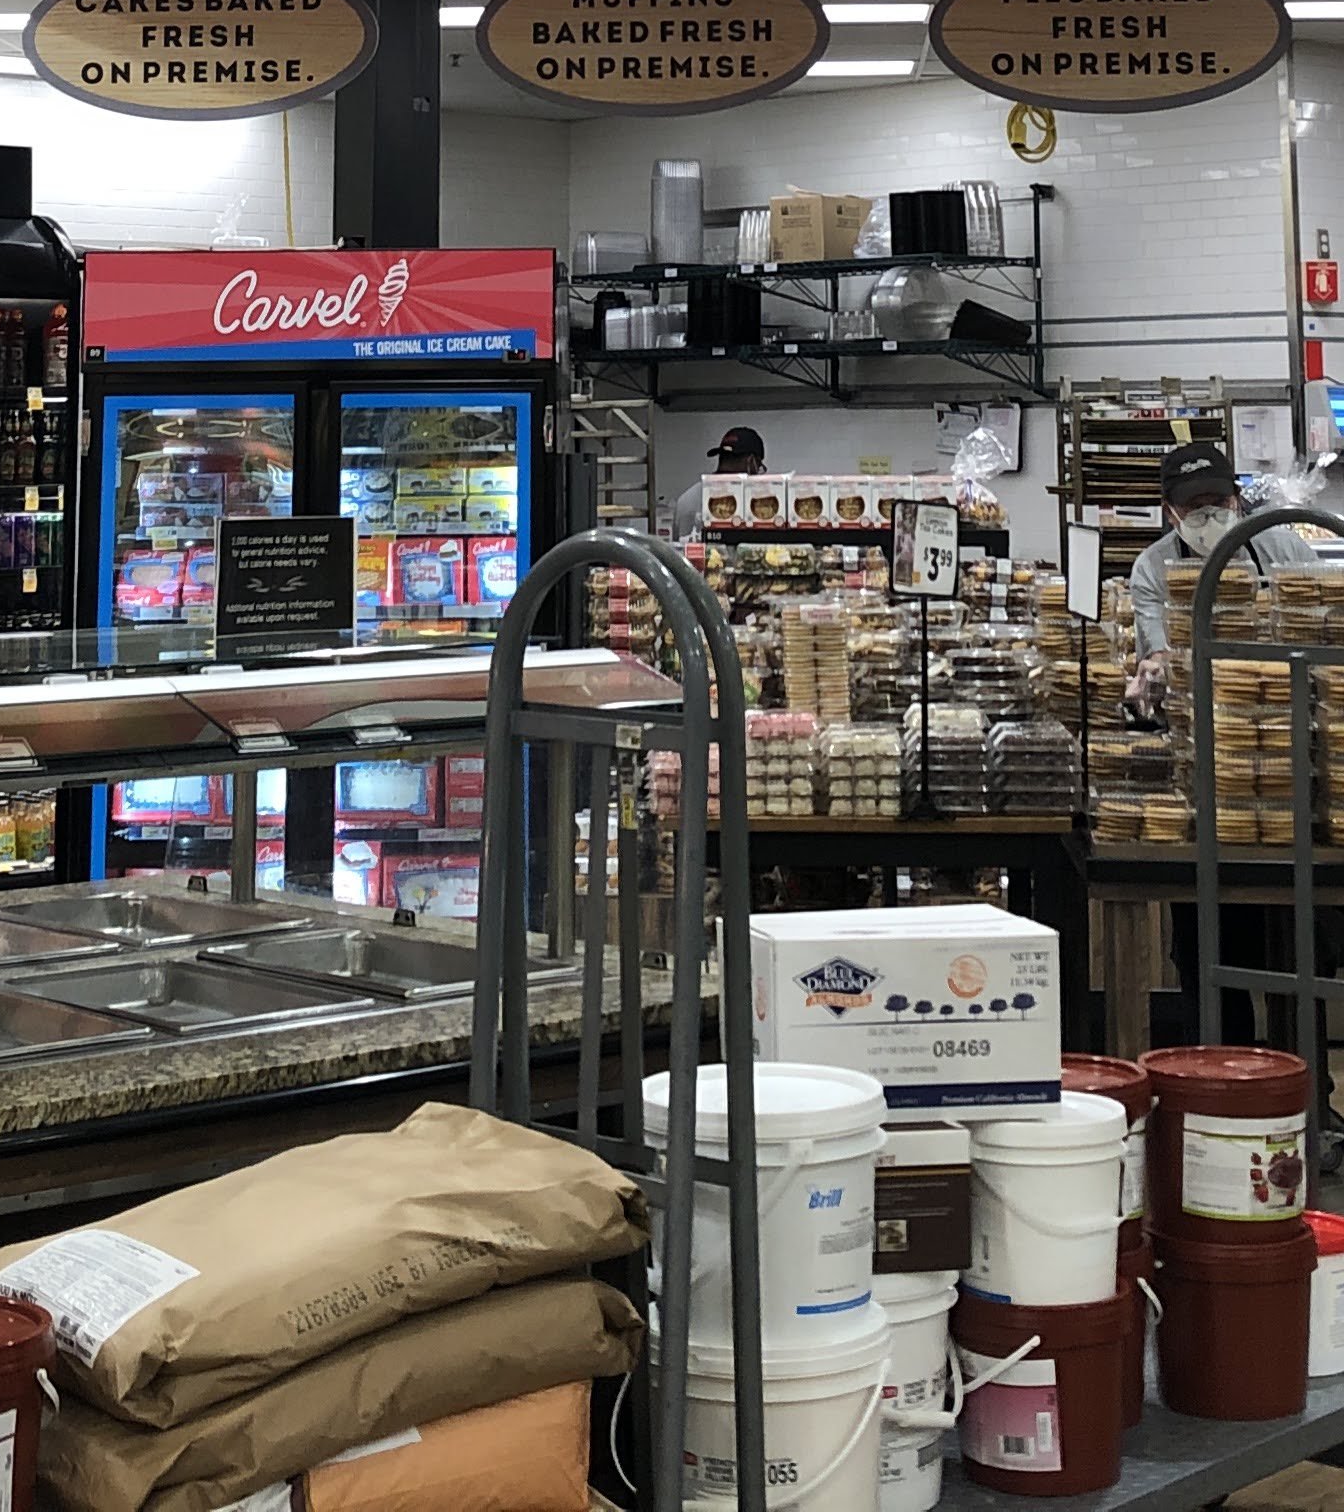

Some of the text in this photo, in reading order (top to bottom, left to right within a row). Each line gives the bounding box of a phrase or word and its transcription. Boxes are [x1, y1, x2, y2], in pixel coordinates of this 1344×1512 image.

[142, 24, 255, 48] FRESH
[532, 18, 773, 45] BAKED FRESH
[1052, 15, 1167, 39] FRESH
[81, 59, 315, 85] ON PREMISE.
[536, 54, 769, 80] ON PREMISE.
[991, 51, 1231, 76] ON PREMISE.
[213, 269, 369, 335] Carvel
[353, 335, 512, 356] THE ORIGINAL ICE CREAM CAKE
[932, 1039, 992, 1059] 08469
[808, 1188, 844, 1209] Brill
[767, 1462, 799, 1485] 055
